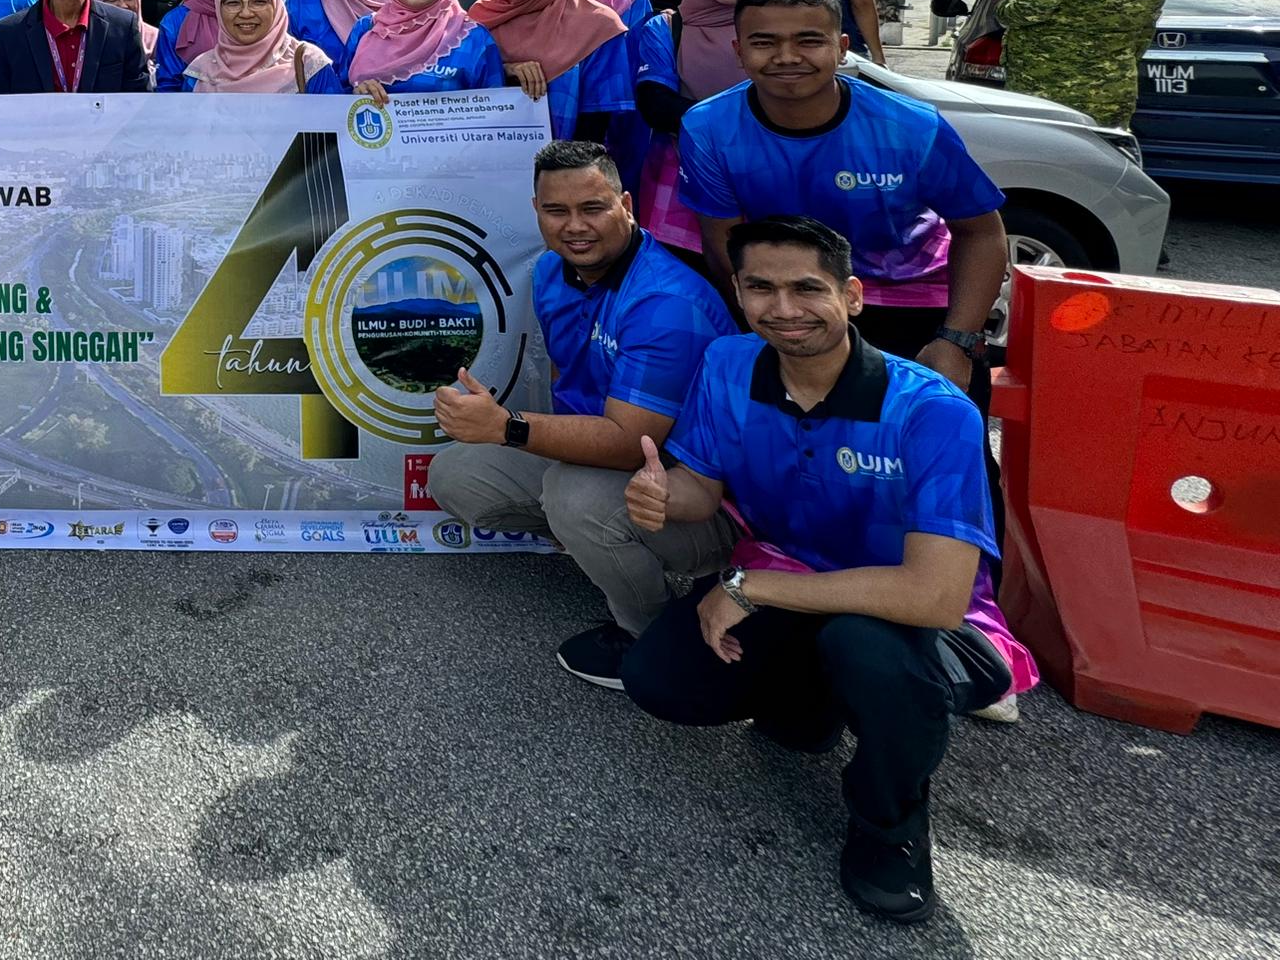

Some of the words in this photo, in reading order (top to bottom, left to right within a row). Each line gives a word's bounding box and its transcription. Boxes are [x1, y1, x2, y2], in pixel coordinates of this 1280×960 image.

[1147, 64, 1194, 79] WUM
[1154, 78, 1188, 94] 1113
[393, 98, 420, 108] Pusat
[422, 97, 439, 106] Hal
[441, 96, 469, 105] Ehwal
[473, 94, 490, 103] dan
[394, 108, 445, 118] Kerjasama
[447, 104, 515, 114] Antarabangsa
[401, 133, 458, 144] Universiti
[461, 132, 493, 142] Utara
[497, 130, 545, 142] Malaysia
[856, 172, 903, 187] UUM
[388, 186, 453, 203] DEKAD
[36, 286, 52, 313] &
[357, 321, 387, 331] ILMU
[399, 319, 427, 329] BUDI
[439, 317, 475, 328] BAKTI
[203, 334, 314, 389] tahun
[407, 459, 412, 471] 1
[301, 530, 345, 541] GOALS
